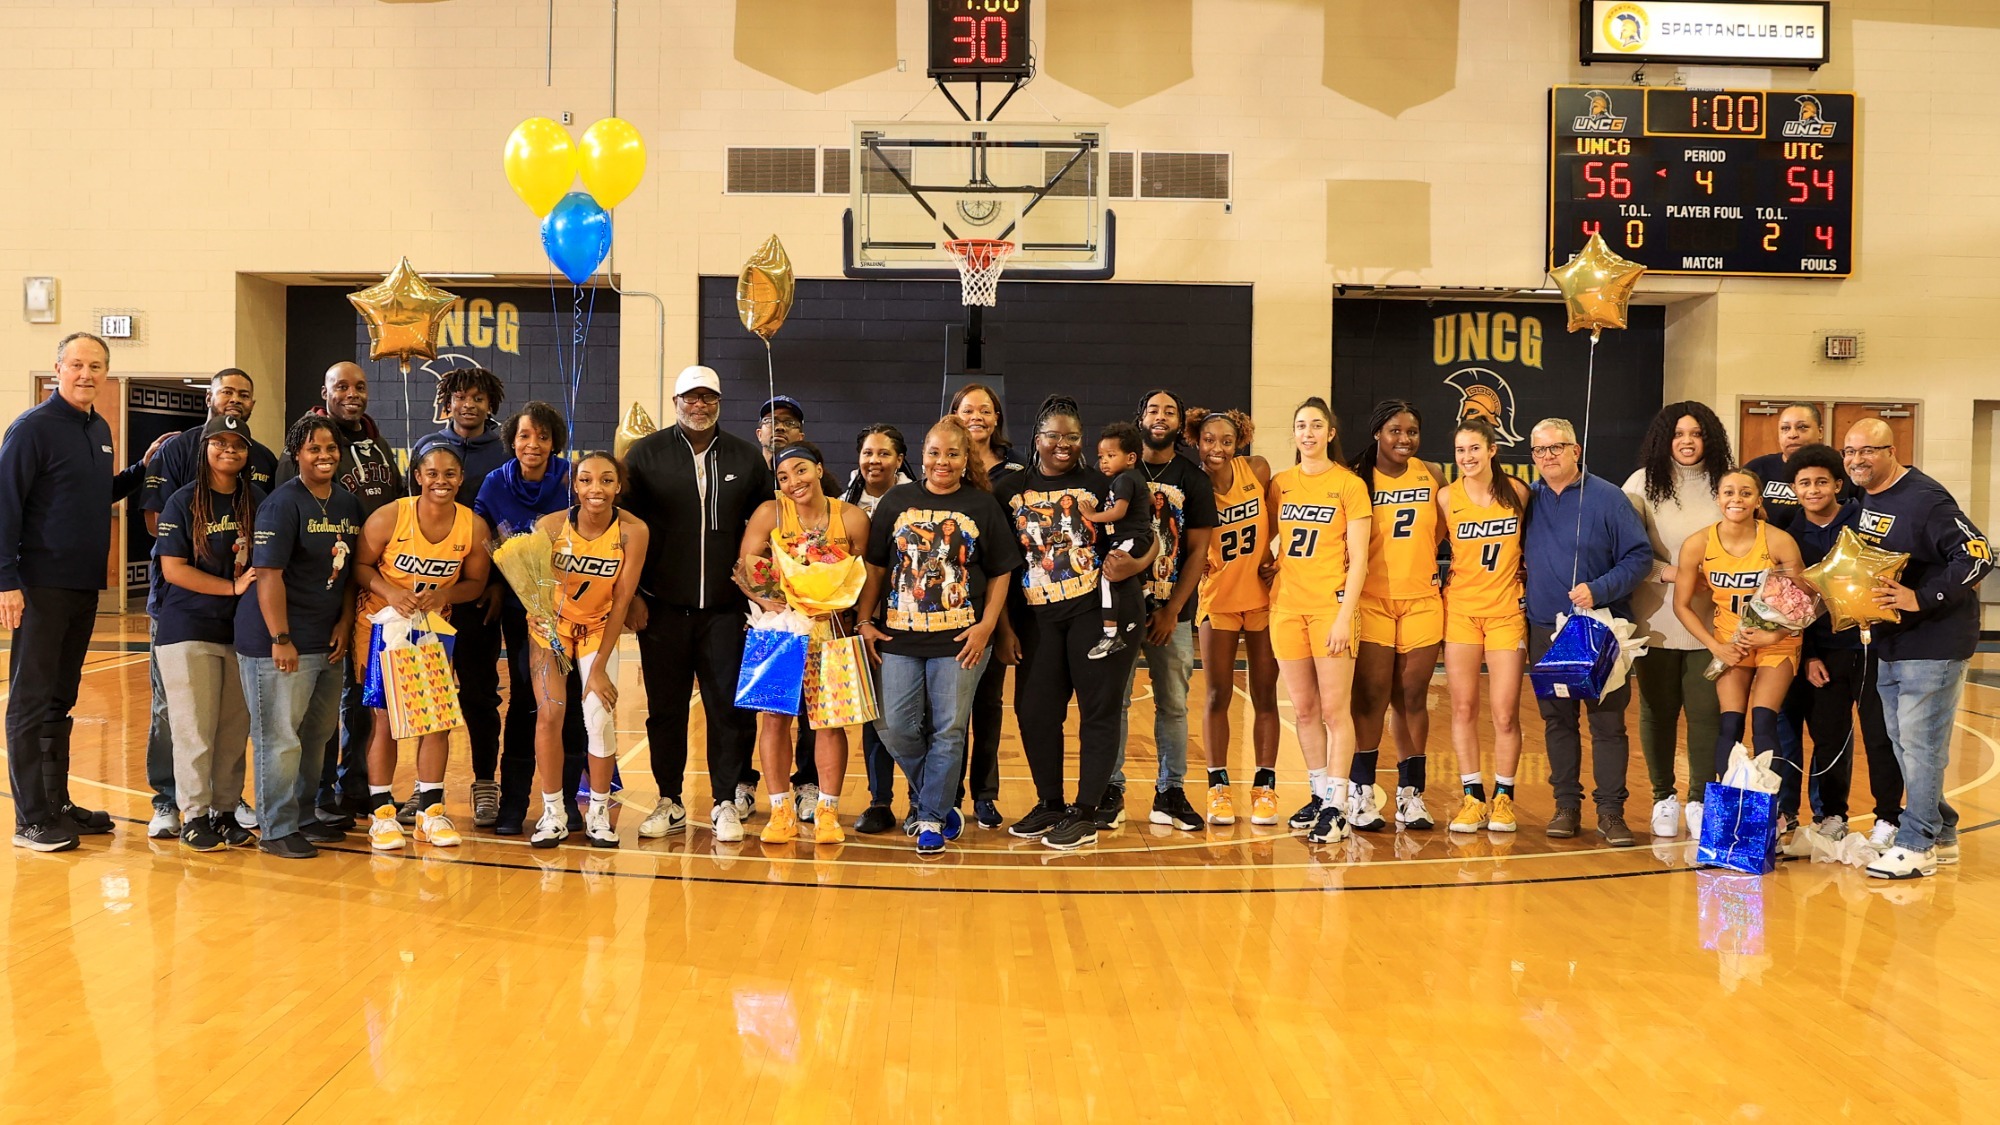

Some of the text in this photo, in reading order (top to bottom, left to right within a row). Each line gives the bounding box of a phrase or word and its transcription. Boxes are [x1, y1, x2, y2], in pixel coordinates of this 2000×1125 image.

[953, 16, 1007, 64] 30
[1661, 22, 1816, 39] SPARTANCLUB.ORG
[1573, 115, 1628, 133] UNCG
[1691, 94, 1759, 132] 1:00
[1782, 119, 1837, 138] UNCG
[1577, 137, 1631, 156] UNCG
[1684, 149, 1727, 163] PERIOD
[1784, 142, 1825, 160] UTC
[1584, 161, 1632, 199] 56
[1696, 169, 1713, 195] 4
[1786, 165, 1835, 203] 54
[1619, 203, 1652, 217] T.O.L.
[1666, 204, 1744, 220] PLAYER FOUL
[1756, 207, 1788, 221] T.O.L.
[1626, 219, 1644, 249] 0
[1763, 222, 1781, 252] 2
[1815, 226, 1834, 250] 4
[1682, 256, 1724, 270] MATCH
[1801, 258, 1838, 272] FOULS
[106, 318, 127, 335] EXIT
[436, 298, 521, 356] NCG
[1433, 311, 1544, 371] UNCG
[1831, 338, 1853, 356] EXIT
[1763, 480, 1799, 500] UN
[1213, 497, 1260, 528] NCG
[1279, 503, 1337, 524] UNCG
[1392, 508, 1416, 539] 2
[1456, 516, 1520, 540] UNCG
[1219, 523, 1257, 563] 23
[1286, 527, 1319, 559] 21
[394, 553, 461, 578] UNCG
[553, 552, 621, 578] UNCG
[1480, 542, 1503, 573] 4
[571, 580, 592, 602] 1
[1709, 570, 1764, 589] UNC
